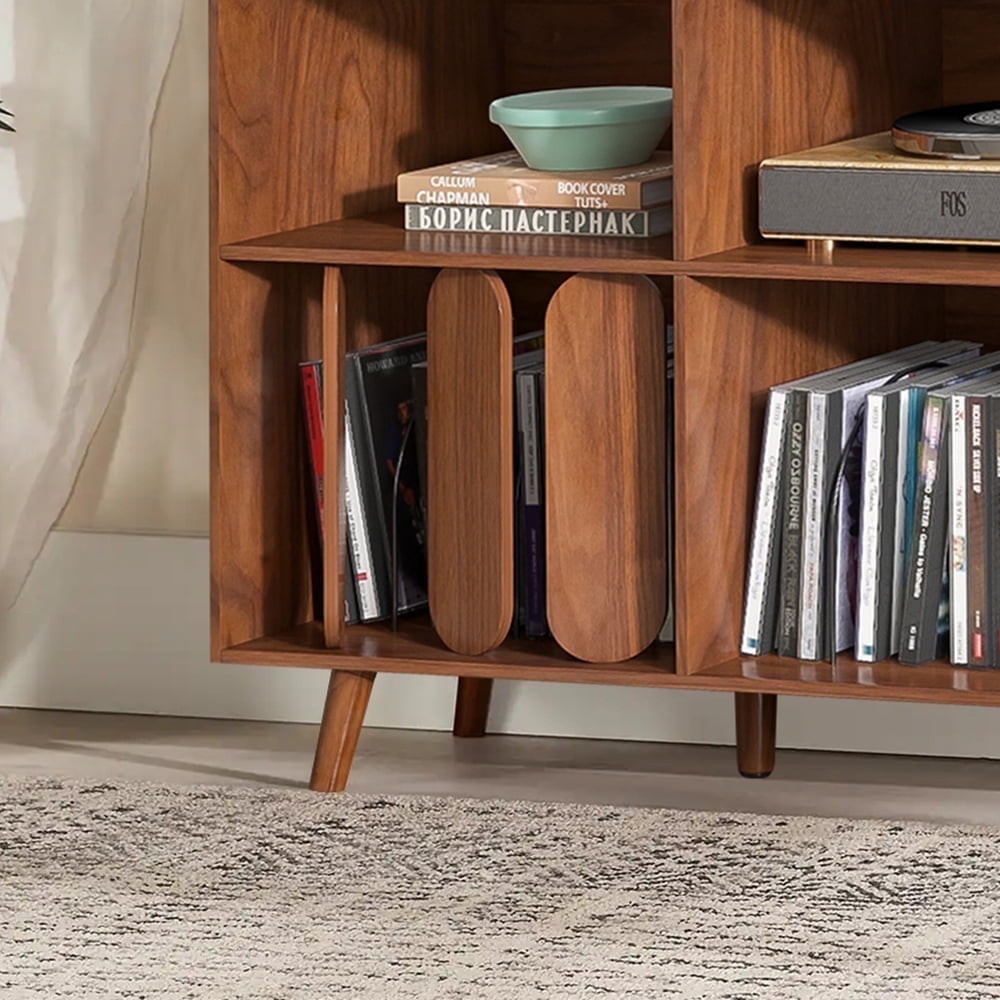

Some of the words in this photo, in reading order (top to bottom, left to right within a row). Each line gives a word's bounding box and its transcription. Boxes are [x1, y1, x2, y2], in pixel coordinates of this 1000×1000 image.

[430, 175, 475, 187] CALLUM
[557, 182, 588, 194] BOOK
[590, 183, 626, 195] COVER
[416, 190, 490, 205] CHAPMAN
[574, 196, 609, 208] TUTS+
[940, 191, 967, 217] FOS
[419, 206, 492, 230] БОРИС
[500, 208, 636, 235] ПАСТЕРНАК
[791, 422, 803, 458] OZZY
[788, 458, 802, 530] OSBOURNE
[921, 495, 931, 528] JESTER
